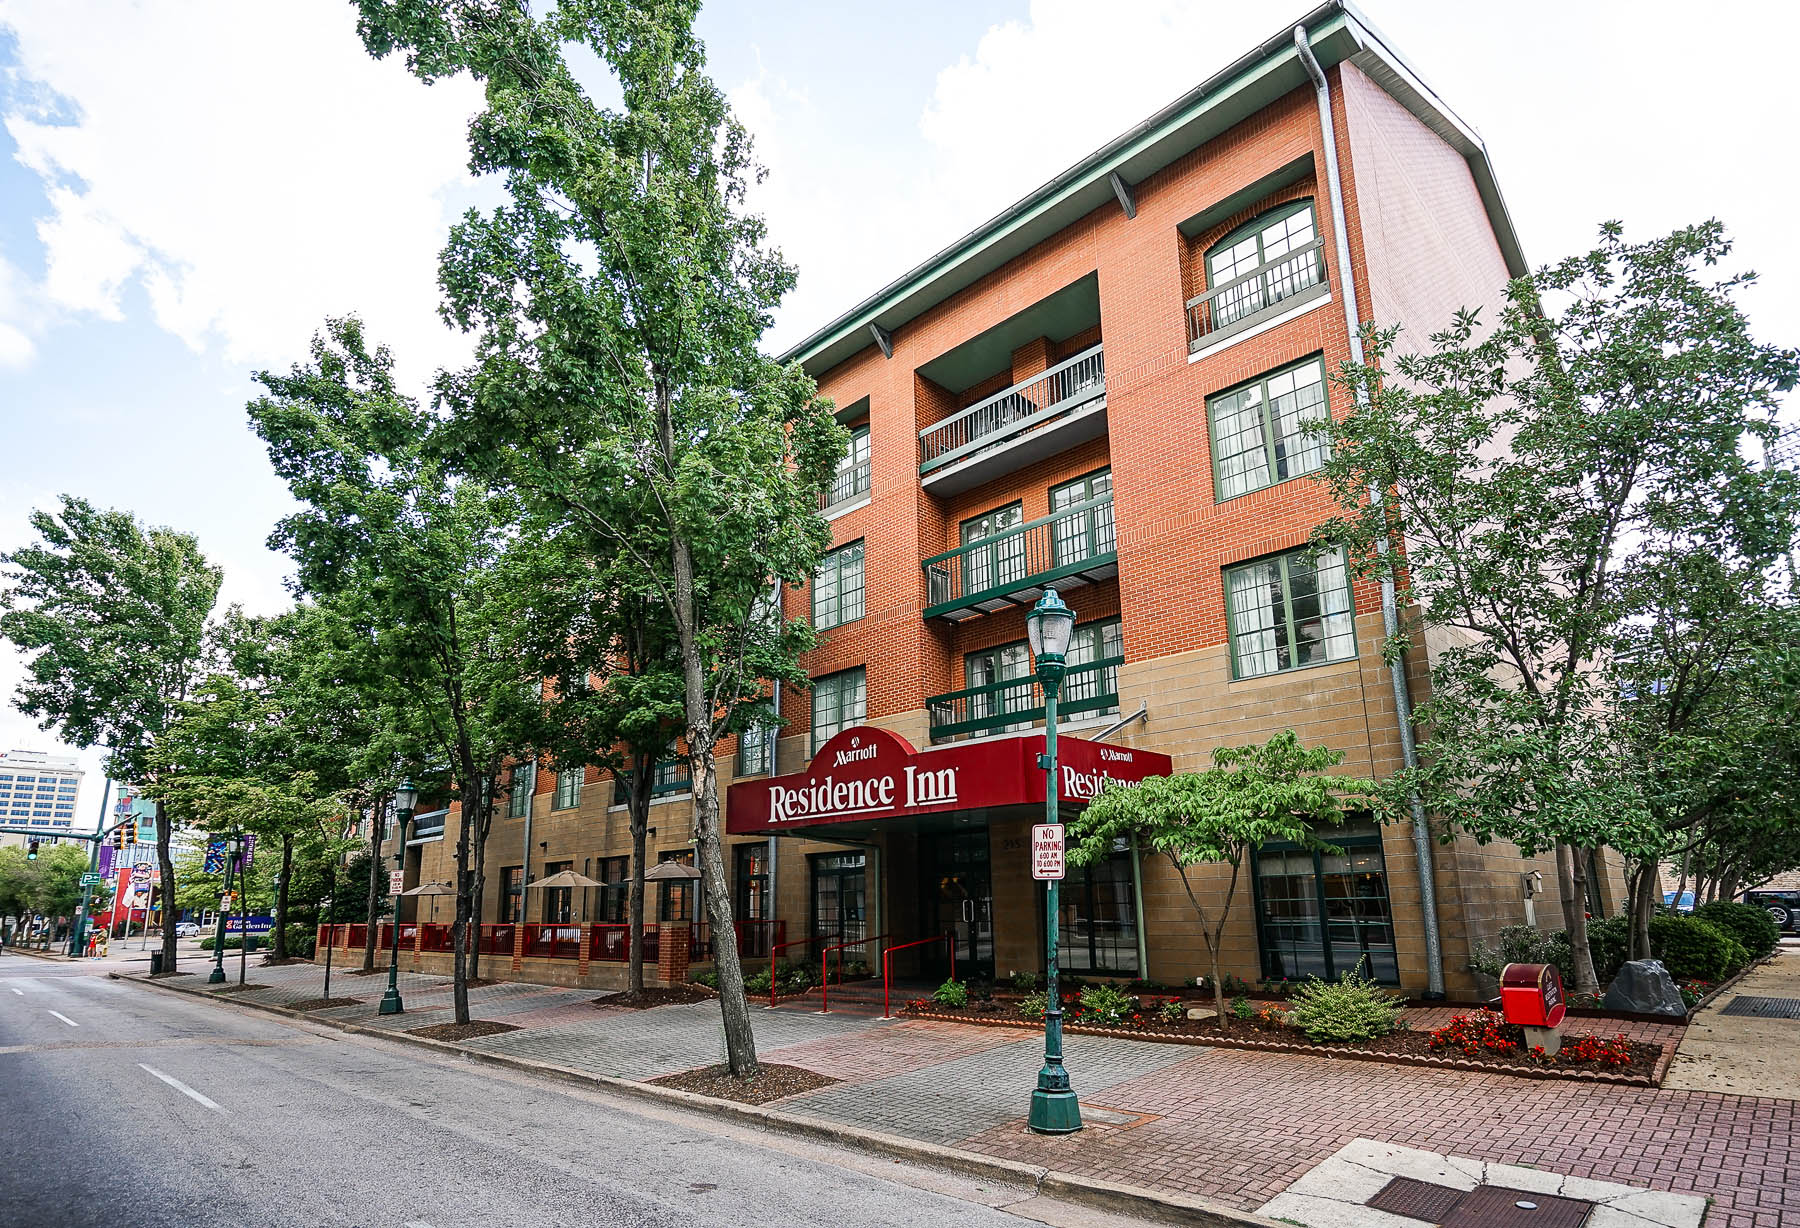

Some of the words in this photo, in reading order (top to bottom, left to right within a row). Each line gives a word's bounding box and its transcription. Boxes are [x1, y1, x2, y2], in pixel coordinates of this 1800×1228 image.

[833, 744, 877, 767] Marriott
[1109, 750, 1132, 762] Marriott
[768, 775, 895, 822] Residence
[904, 766, 957, 807] Inn
[1042, 829, 1054, 839] NO
[1035, 841, 1061, 851] PARKING
[84, 875, 92, 883] P
